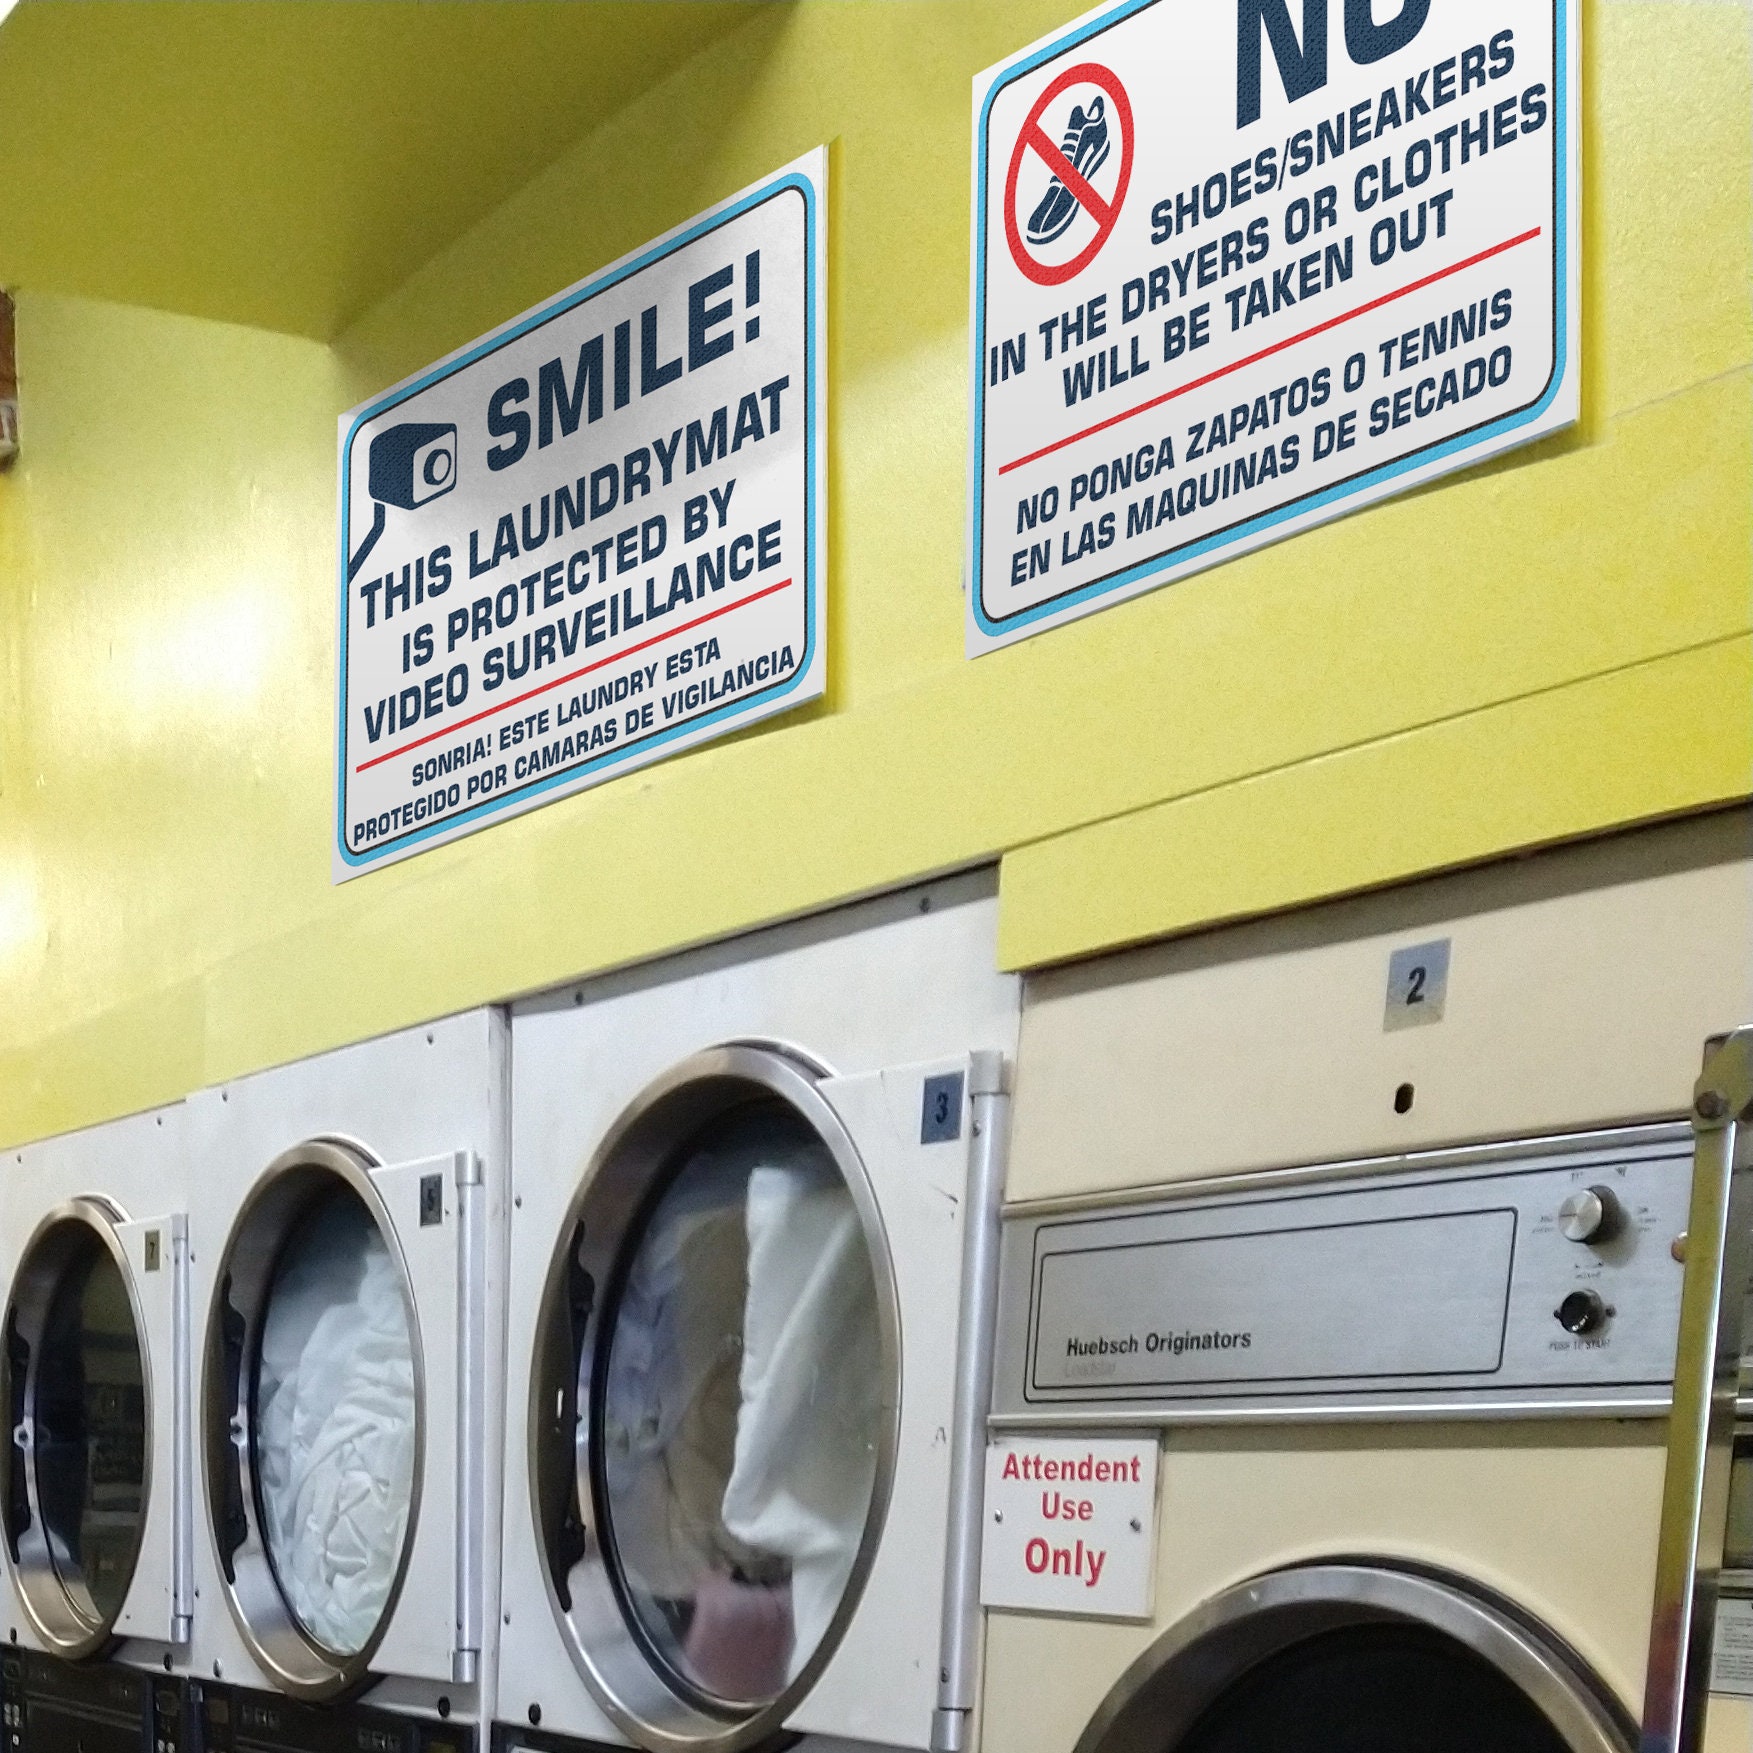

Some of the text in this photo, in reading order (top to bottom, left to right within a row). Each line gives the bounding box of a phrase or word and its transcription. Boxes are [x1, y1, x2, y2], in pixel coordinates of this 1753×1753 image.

[991, 83, 1548, 388] IN THE DRYERS OR CLOTHES
[1151, 30, 1516, 247] SHOES/SNEAKERS
[486, 249, 761, 473] SMILE!
[1063, 189, 1455, 409] WILL BE TAKEN OUT
[361, 375, 791, 630] THIS LAUNDRYMAT
[1011, 346, 1513, 588] EN LAS MAQUINAS DE SECADO
[1017, 289, 1513, 536] NO PONGA ZAPATOS O TENNIS
[364, 520, 783, 745] VIDEO SURVEILLANCE
[403, 479, 738, 675] IS PROTECTED BY
[354, 645, 796, 848] PROTEGIDO POR CAMARAS DE VIGILANCIA
[413, 638, 722, 788] SONRIA! ESTE LAUNDRY ESTA
[1406, 966, 1426, 1006] 2
[935, 1091, 949, 1124] 3
[1066, 1330, 1252, 1356] Huebsch Originators
[1002, 1452, 1141, 1483] Attendent
[1025, 1537, 1107, 1588] Only
[1042, 1491, 1094, 1521] Use
